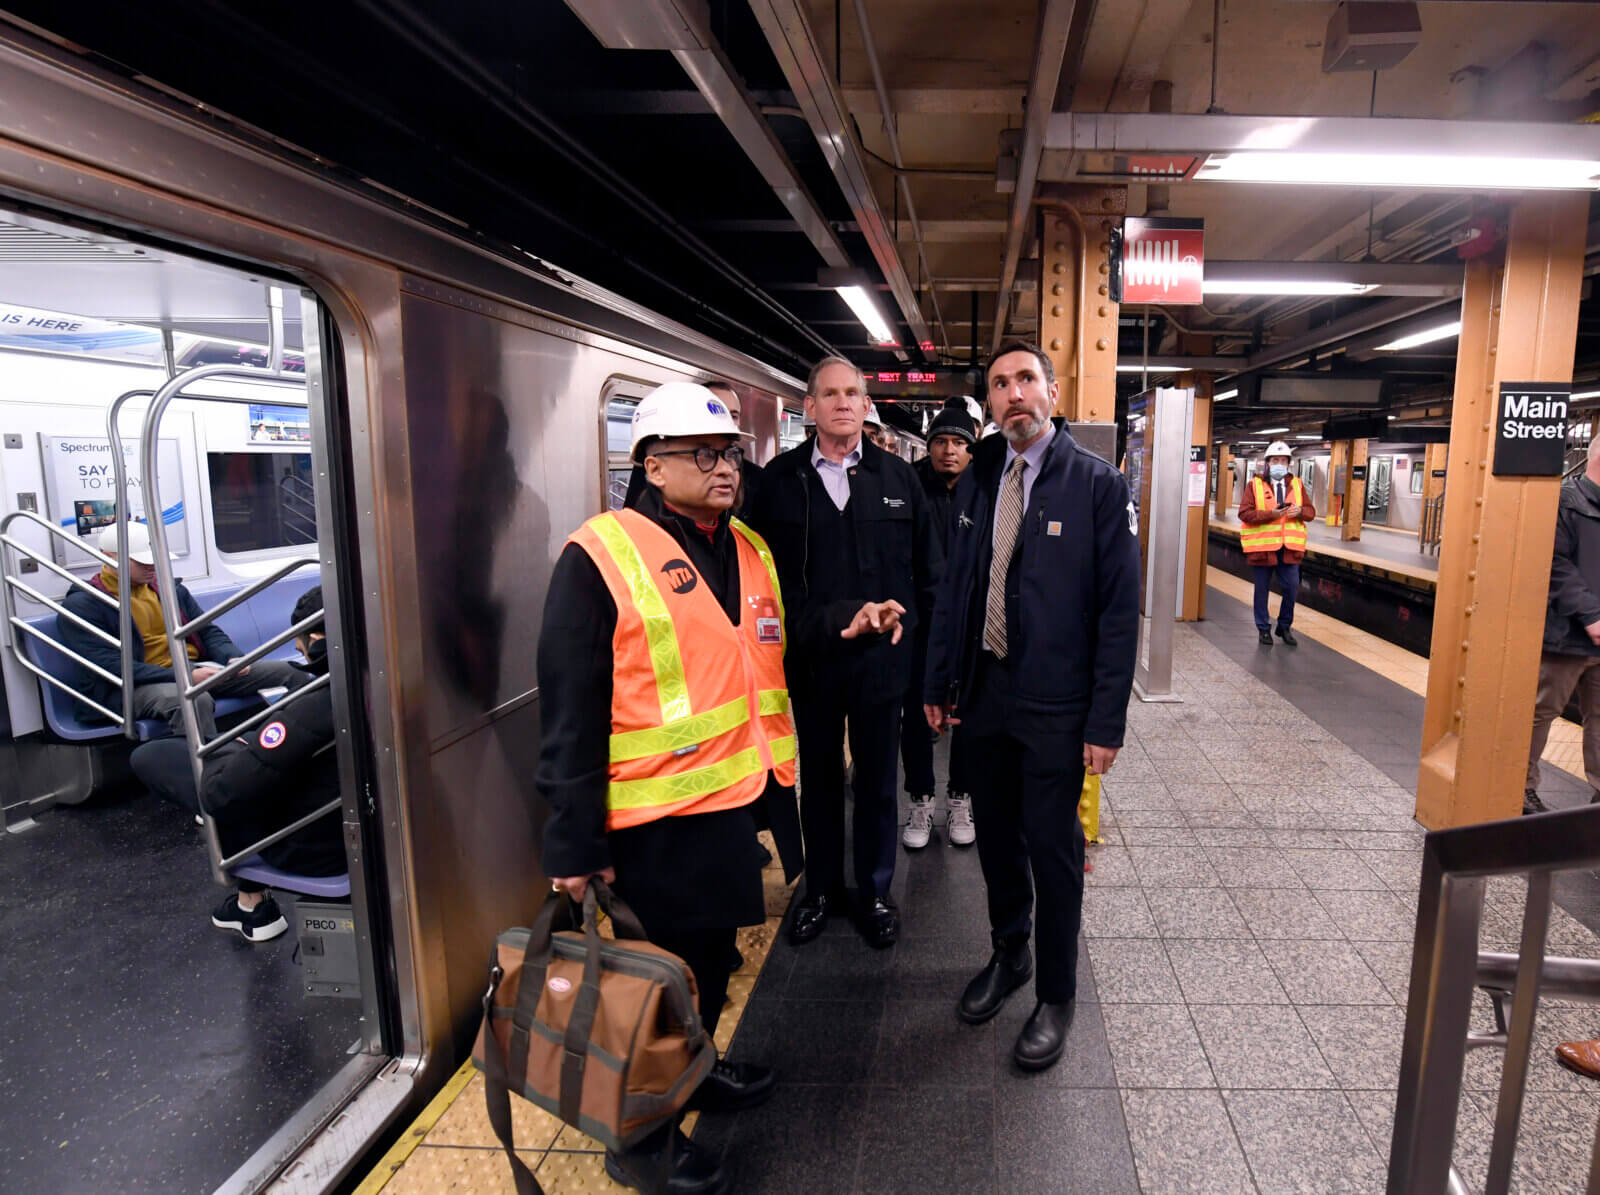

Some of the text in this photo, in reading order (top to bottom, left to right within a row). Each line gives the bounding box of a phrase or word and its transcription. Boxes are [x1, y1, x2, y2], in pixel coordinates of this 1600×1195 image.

[2, 313, 83, 332] IS HERE
[907, 373, 937, 382] TRAIN
[1503, 395, 1568, 419] Main
[1502, 420, 1566, 439] Street
[78, 465, 108, 476] SAY
[80, 476, 142, 489] TO PAY
[661, 564, 696, 592] MTA
